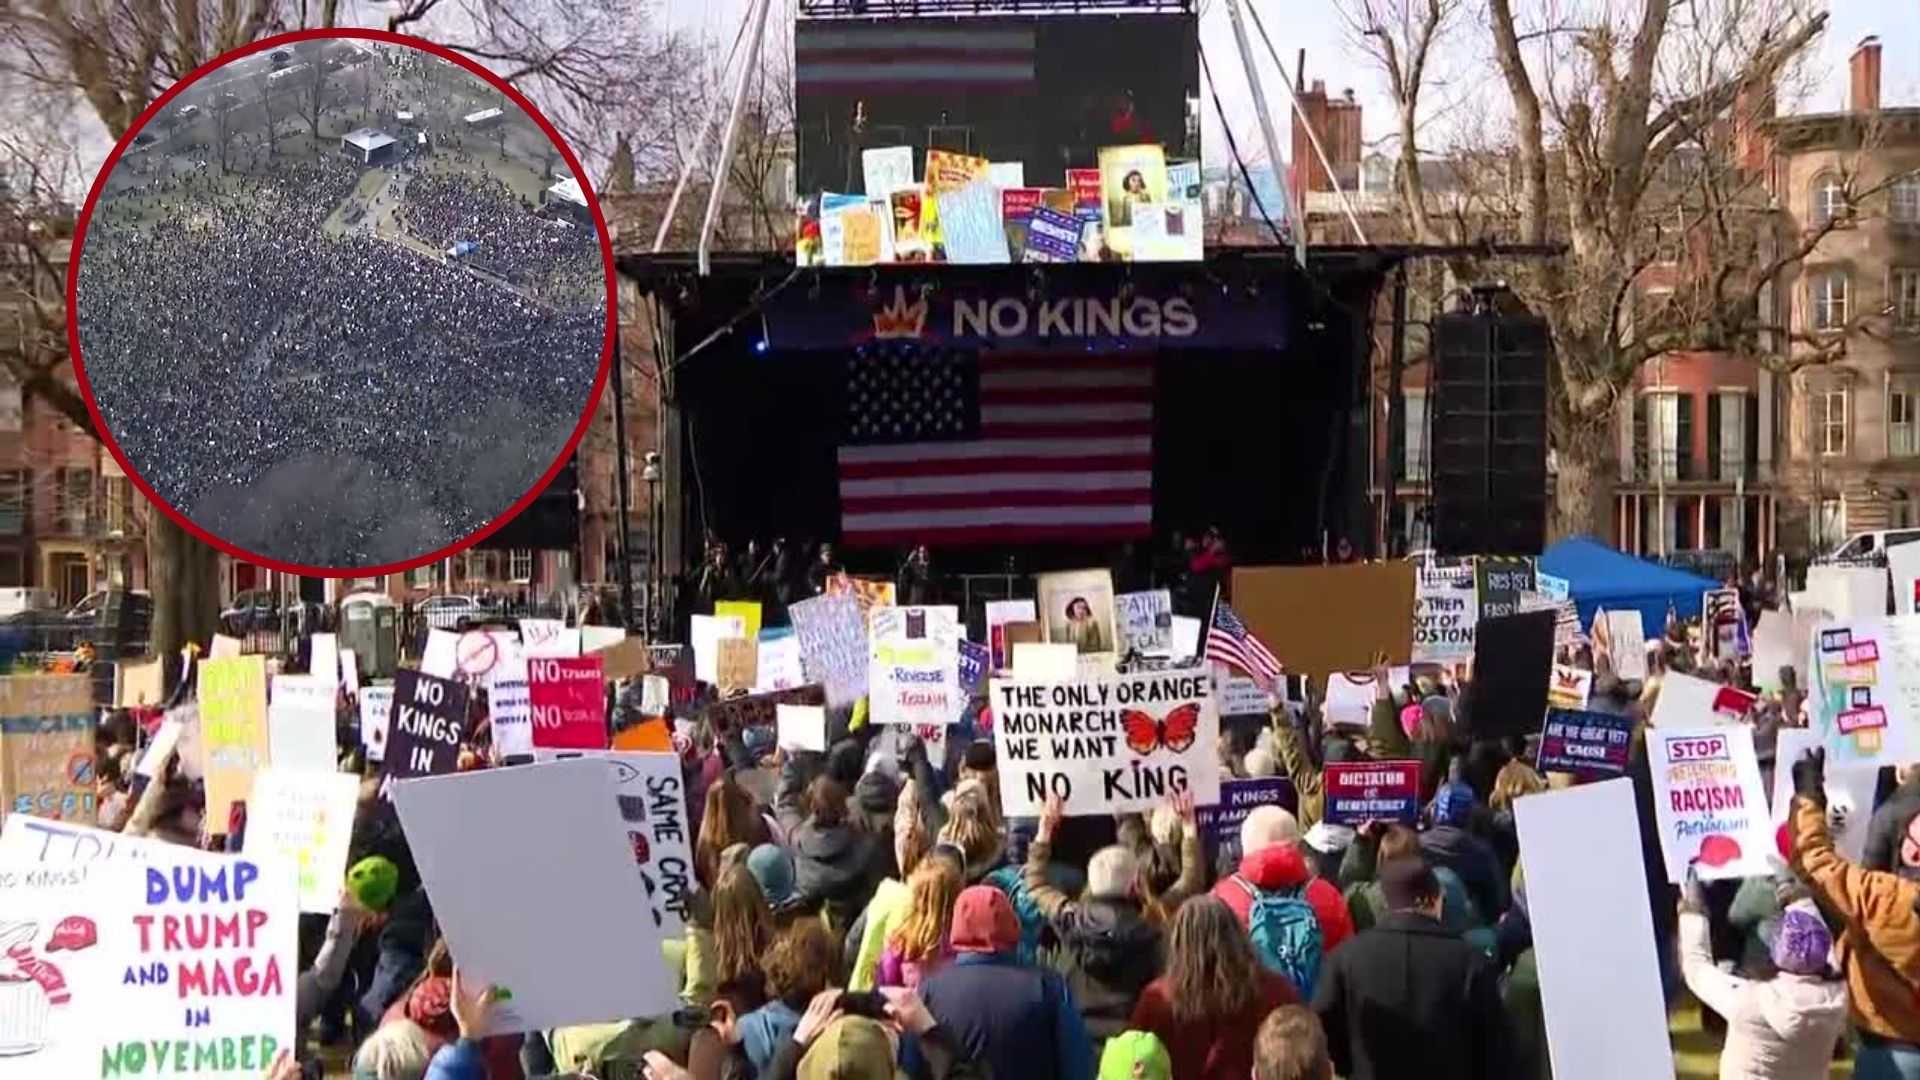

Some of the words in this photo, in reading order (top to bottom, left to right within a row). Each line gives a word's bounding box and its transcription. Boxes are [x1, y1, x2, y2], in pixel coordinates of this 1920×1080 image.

[953, 298, 1028, 338] NO
[1038, 298, 1199, 338] KINGS
[1426, 598, 1465, 611] THEM
[1440, 614, 1460, 628] OF
[1415, 629, 1473, 643] OSTON
[531, 660, 561, 683] NO
[414, 678, 444, 706] NO
[1001, 685, 1046, 708] THE
[1052, 682, 1109, 706] ONLY
[1116, 676, 1207, 703] ORANGE
[398, 704, 462, 745] KINGS
[533, 705, 562, 729] NO
[1003, 709, 1117, 735] MONARCH
[410, 746, 434, 772] IN
[1007, 739, 1041, 760] WE
[1052, 736, 1118, 759] WANT
[1672, 740, 1722, 758] STOP
[1026, 771, 1072, 802] NO
[1231, 789, 1279, 805] KINGS
[1670, 785, 1745, 812] RACISM
[646, 776, 683, 844] SAME
[146, 861, 258, 904] DUMP
[658, 857, 690, 922] CRAP
[133, 909, 268, 952] TRUMP
[123, 963, 169, 986] AND
[178, 954, 283, 999] MAGA
[185, 1007, 211, 1027] IN
[102, 1034, 278, 1079] NOVEMBER
